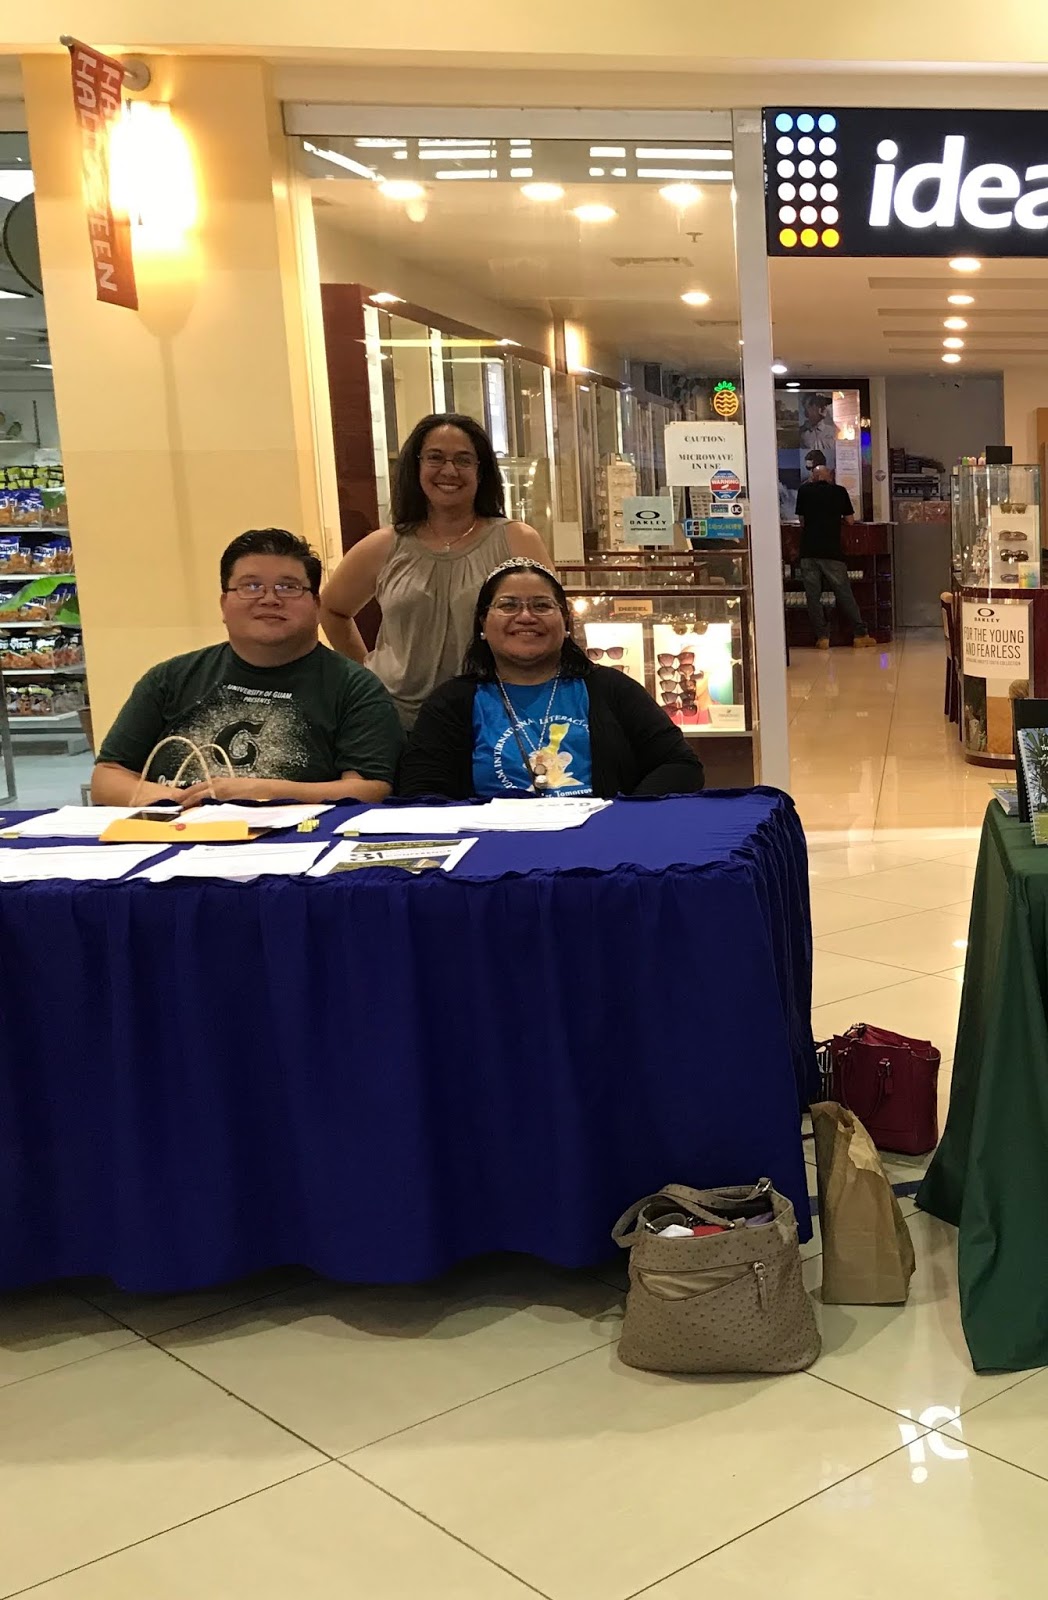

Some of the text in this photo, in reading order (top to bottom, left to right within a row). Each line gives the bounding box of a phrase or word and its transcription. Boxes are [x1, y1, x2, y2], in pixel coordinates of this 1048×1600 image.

[76, 51, 118, 292] HALEEN
[869, 135, 1048, 229] idea
[964, 626, 1024, 643] FOR THE YOUNG
[966, 642, 1021, 659] AND FEARLESS
[226, 684, 264, 696] UNIVERSITY
[272, 691, 293, 699] GUAM
[243, 696, 271, 704] PRESENTS
